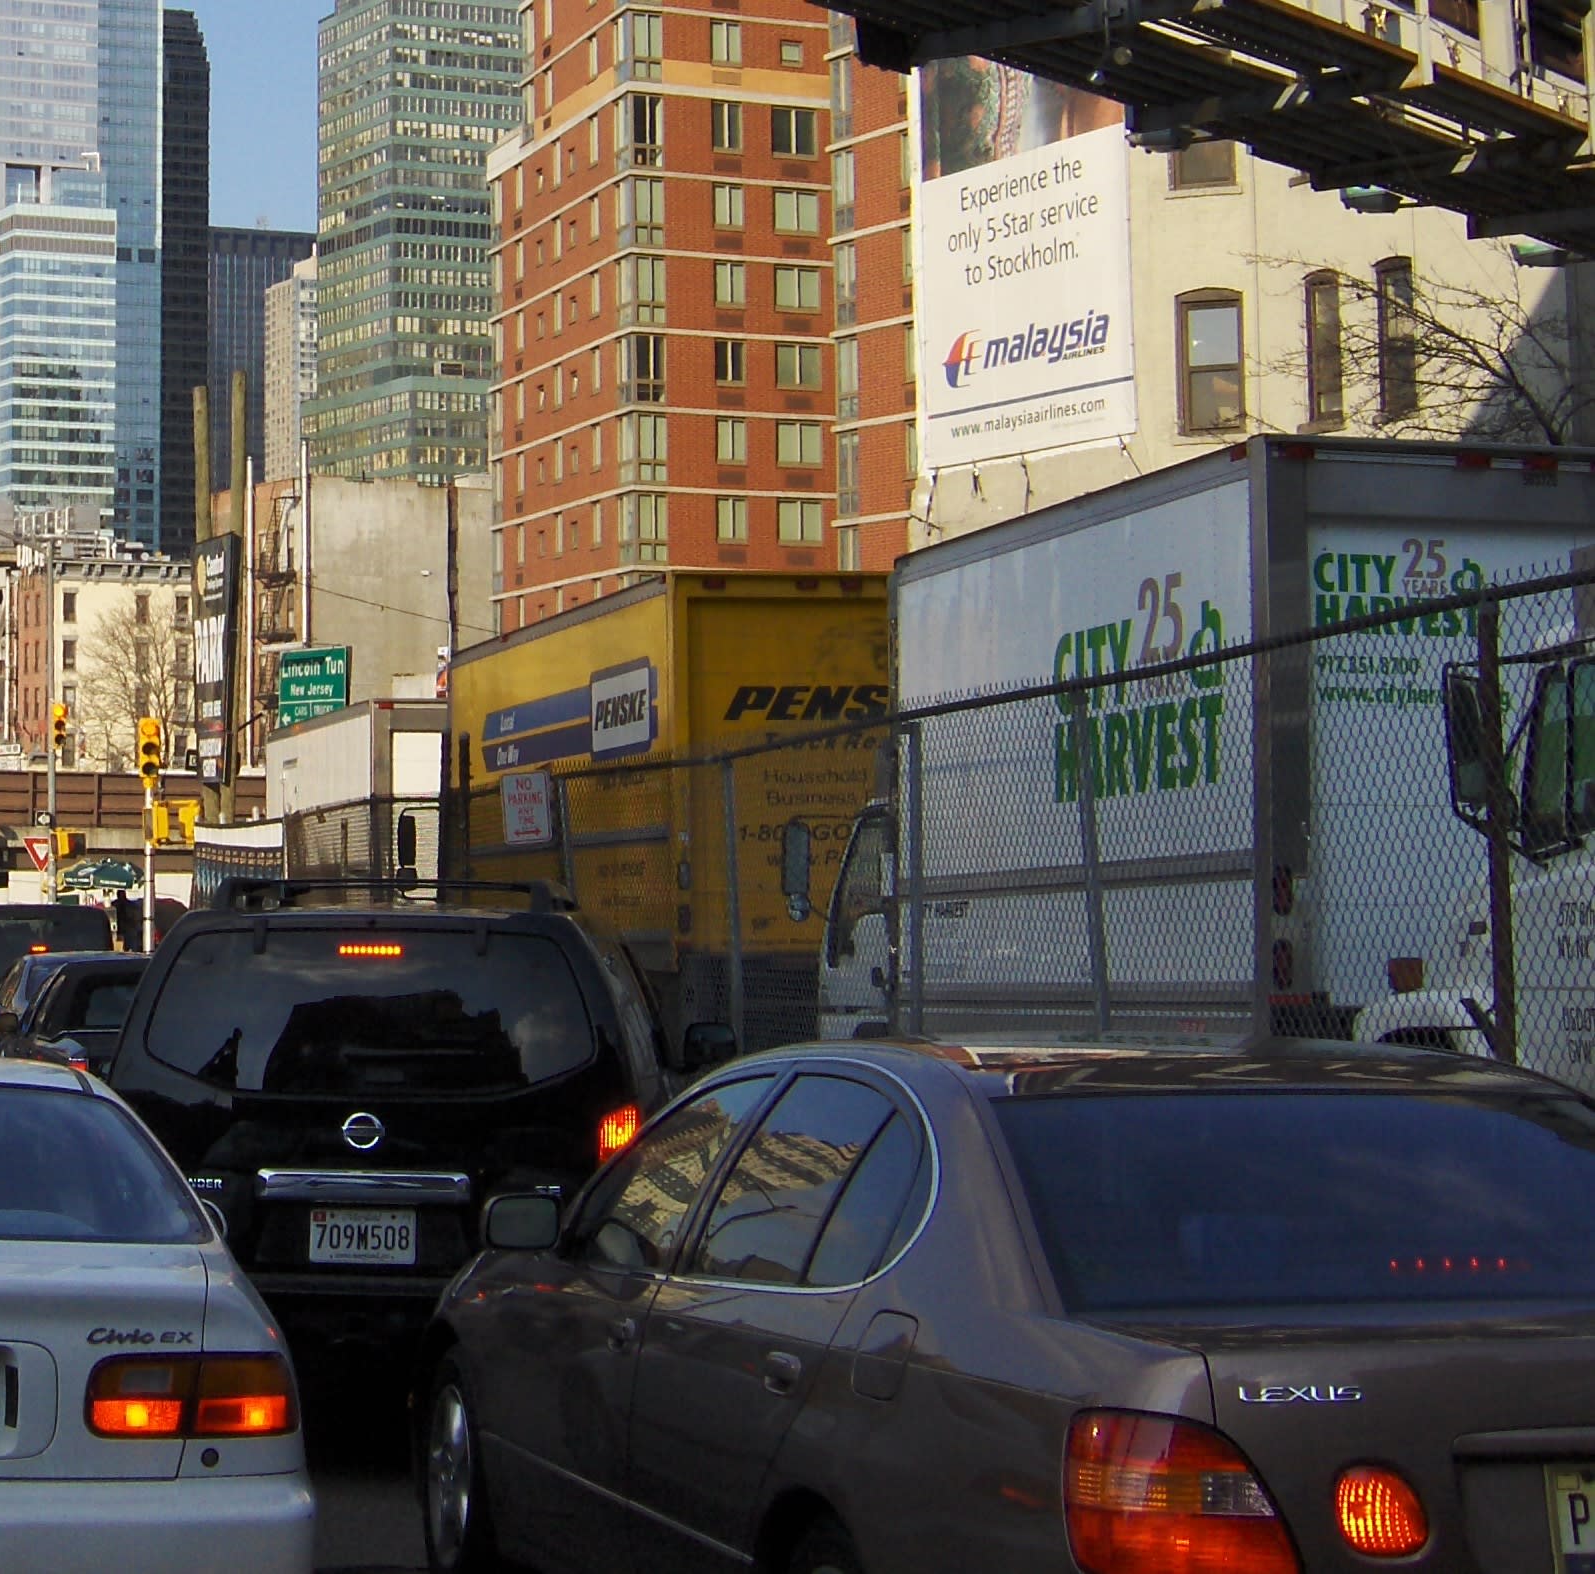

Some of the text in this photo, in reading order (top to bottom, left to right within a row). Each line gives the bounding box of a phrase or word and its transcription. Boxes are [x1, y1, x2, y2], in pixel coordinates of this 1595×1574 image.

[960, 157, 1083, 213] Experience the
[947, 192, 1098, 253] only 5-Star service
[964, 237, 1079, 286] to Stockholm.
[983, 309, 1110, 370] malaysia
[1061, 346, 1105, 361] AIRLINES
[951, 398, 1105, 438] www.malaysiaairlines.com
[1313, 538, 1447, 594] CITY 25
[1402, 579, 1448, 596] YEARS
[1315, 594, 1479, 637] HARVEST
[194, 613, 226, 684] PARK
[1054, 572, 1183, 716] CITY 25
[325, 656, 344, 675] Tun
[290, 682, 334, 697] New Jersey
[594, 688, 647, 731] PENSKE
[1056, 693, 1225, 803] HARVEST
[507, 791, 543, 806] PARKING
[515, 778, 533, 790] NO
[316, 1224, 410, 1250] 709M508
[86, 1327, 194, 1345] Civic EX
[1238, 1385, 1363, 1403] LEXUS
